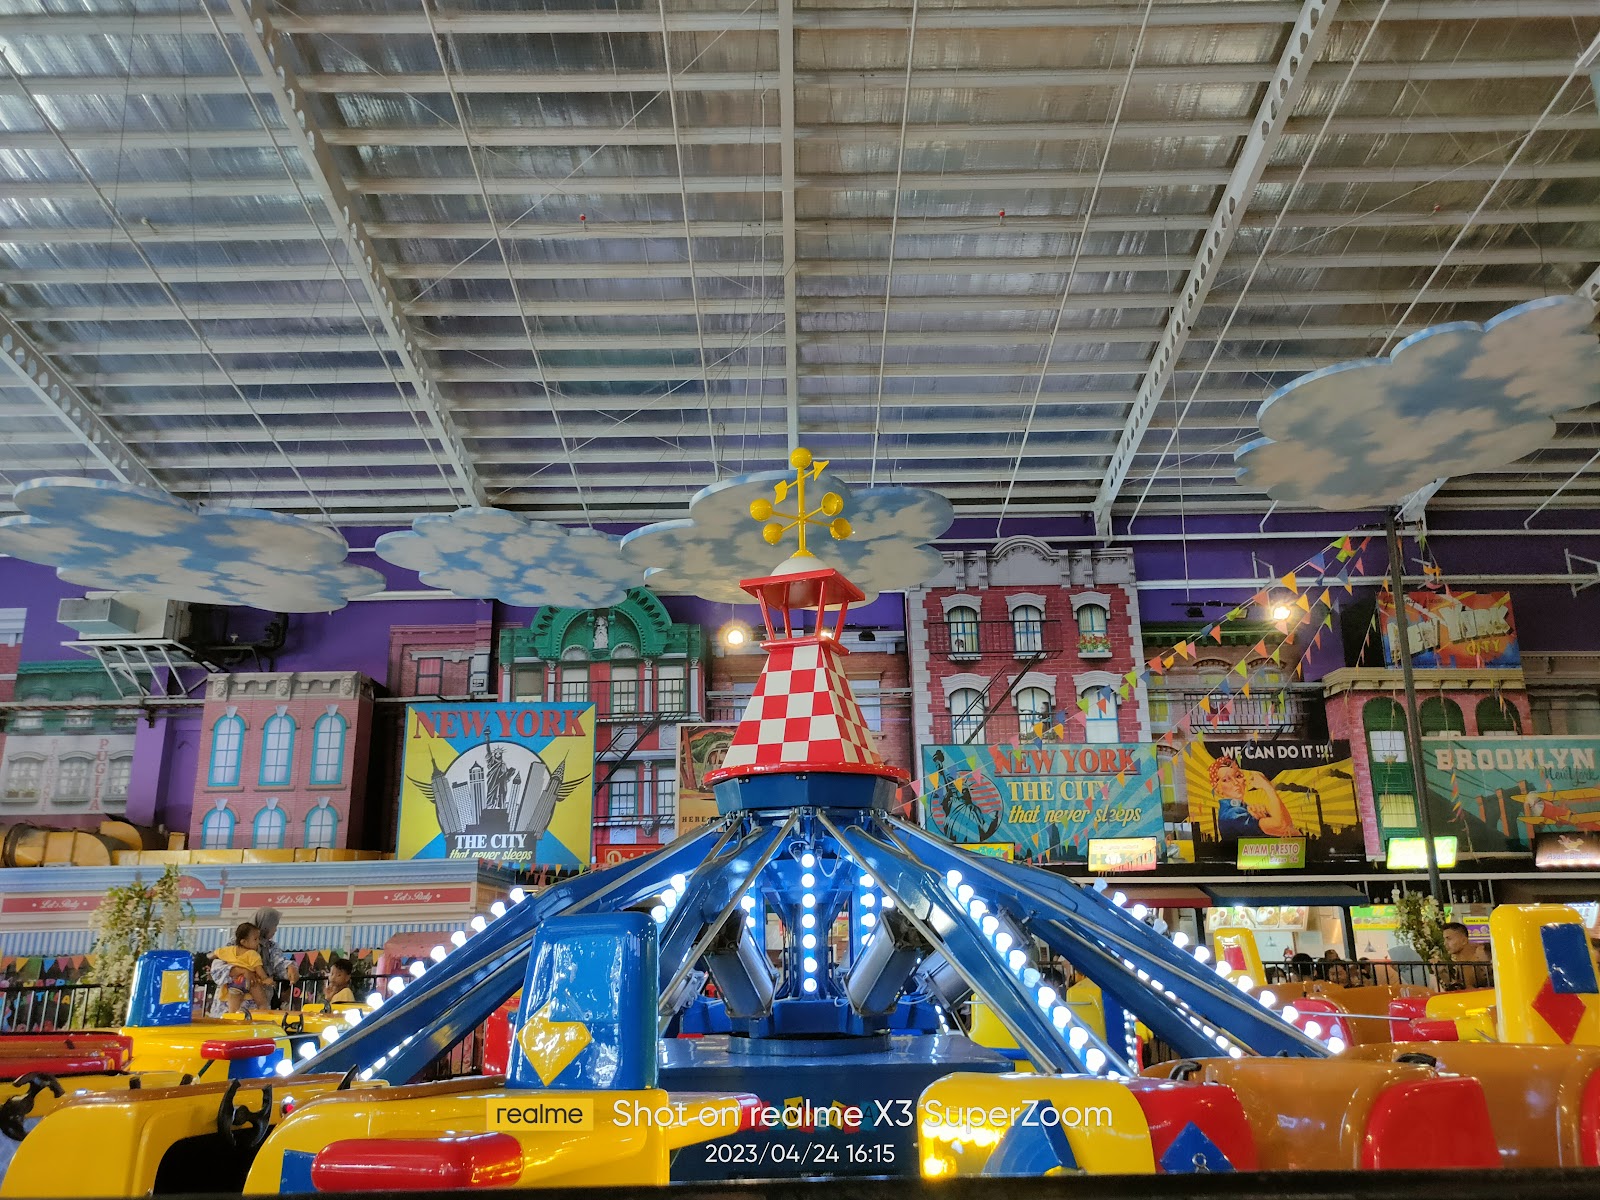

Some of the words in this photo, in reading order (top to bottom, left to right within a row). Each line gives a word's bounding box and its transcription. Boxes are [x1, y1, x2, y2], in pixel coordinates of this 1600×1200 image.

[1465, 639, 1500, 656] CITY
[413, 709, 490, 739] NEW
[496, 709, 586, 737] YORK
[1220, 745, 1243, 760] WE
[1244, 745, 1275, 759] CAN
[1277, 745, 1299, 759] DO
[1301, 744, 1313, 759] IT
[1434, 748, 1595, 770] BROOKLYN
[994, 749, 1056, 774] NEW
[1060, 748, 1138, 774] YORK
[88, 738, 109, 811] PUGLIA
[1007, 781, 1055, 801] THE
[1060, 780, 1111, 801] CITY
[1007, 804, 1041, 824] that
[1044, 809, 1091, 823] never
[1095, 803, 1142, 827] sleeps
[455, 834, 488, 849] THE
[490, 833, 527, 848] CITY
[1243, 845, 1268, 855] AYAM
[1270, 844, 1299, 855] PRESTO
[449, 848, 471, 859] that
[501, 848, 533, 862] sleeps
[293, 895, 313, 905] Party
[411, 891, 433, 902] Party
